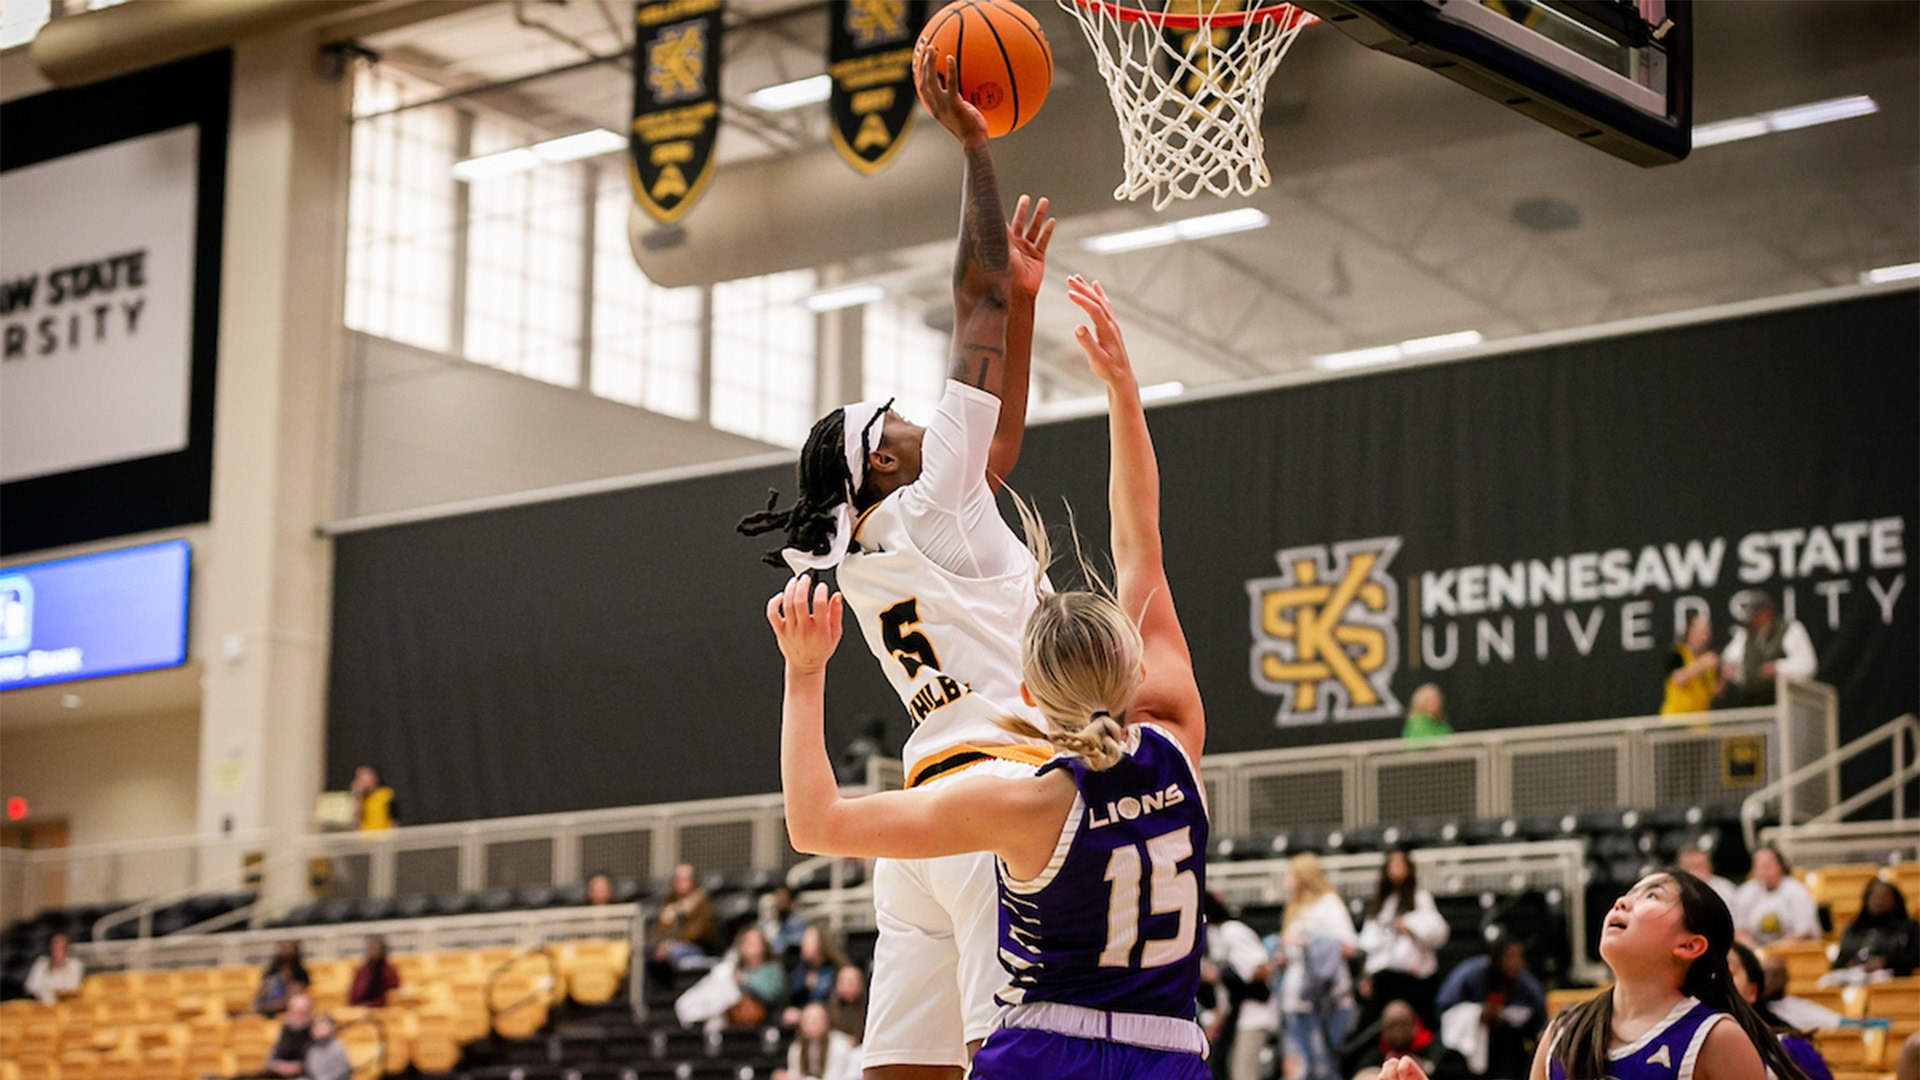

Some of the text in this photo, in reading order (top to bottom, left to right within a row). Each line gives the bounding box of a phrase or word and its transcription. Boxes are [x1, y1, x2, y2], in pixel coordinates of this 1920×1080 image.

[46, 248, 148, 308] STATE
[3, 296, 147, 362] RSITY
[1421, 516, 1907, 618] KENNESAW STATE
[878, 595, 942, 681] 5
[909, 675, 974, 731] HILB
[1088, 783, 1186, 830] LIONS
[1098, 825, 1199, 968] 15
